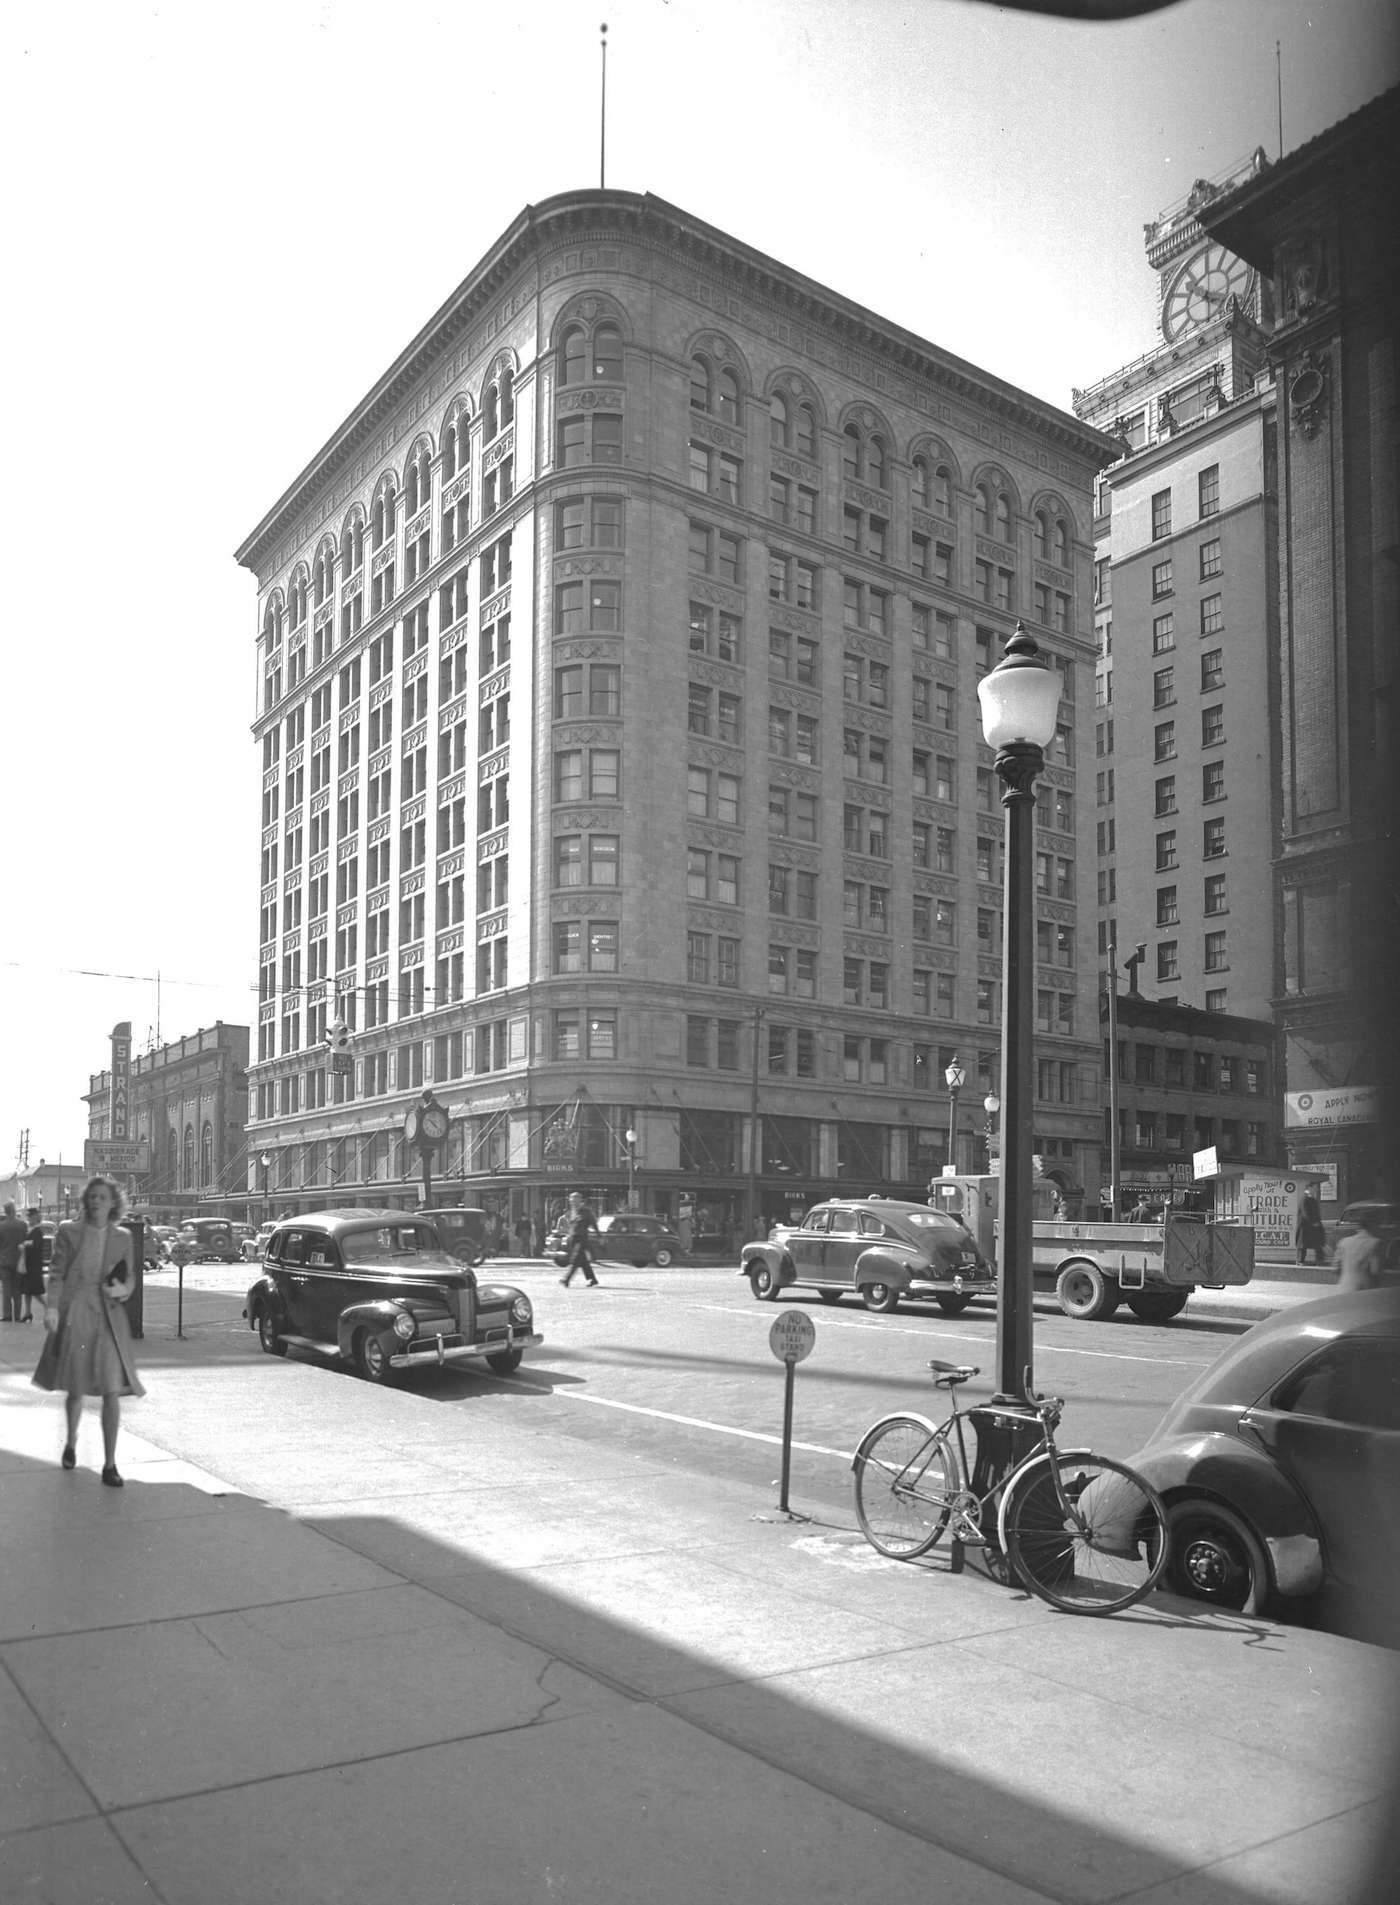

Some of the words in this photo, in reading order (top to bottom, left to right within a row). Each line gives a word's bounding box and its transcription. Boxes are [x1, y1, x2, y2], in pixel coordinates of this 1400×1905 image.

[115, 1045, 127, 1137] STRAND
[1325, 1096, 1350, 1109] APPLY
[1308, 1116, 1335, 1125] ROYAL
[784, 1191, 806, 1199] BIRKS
[1247, 1195, 1288, 1208] TRADE
[788, 1314, 801, 1325] NO
[774, 1322, 814, 1336] PARKING
